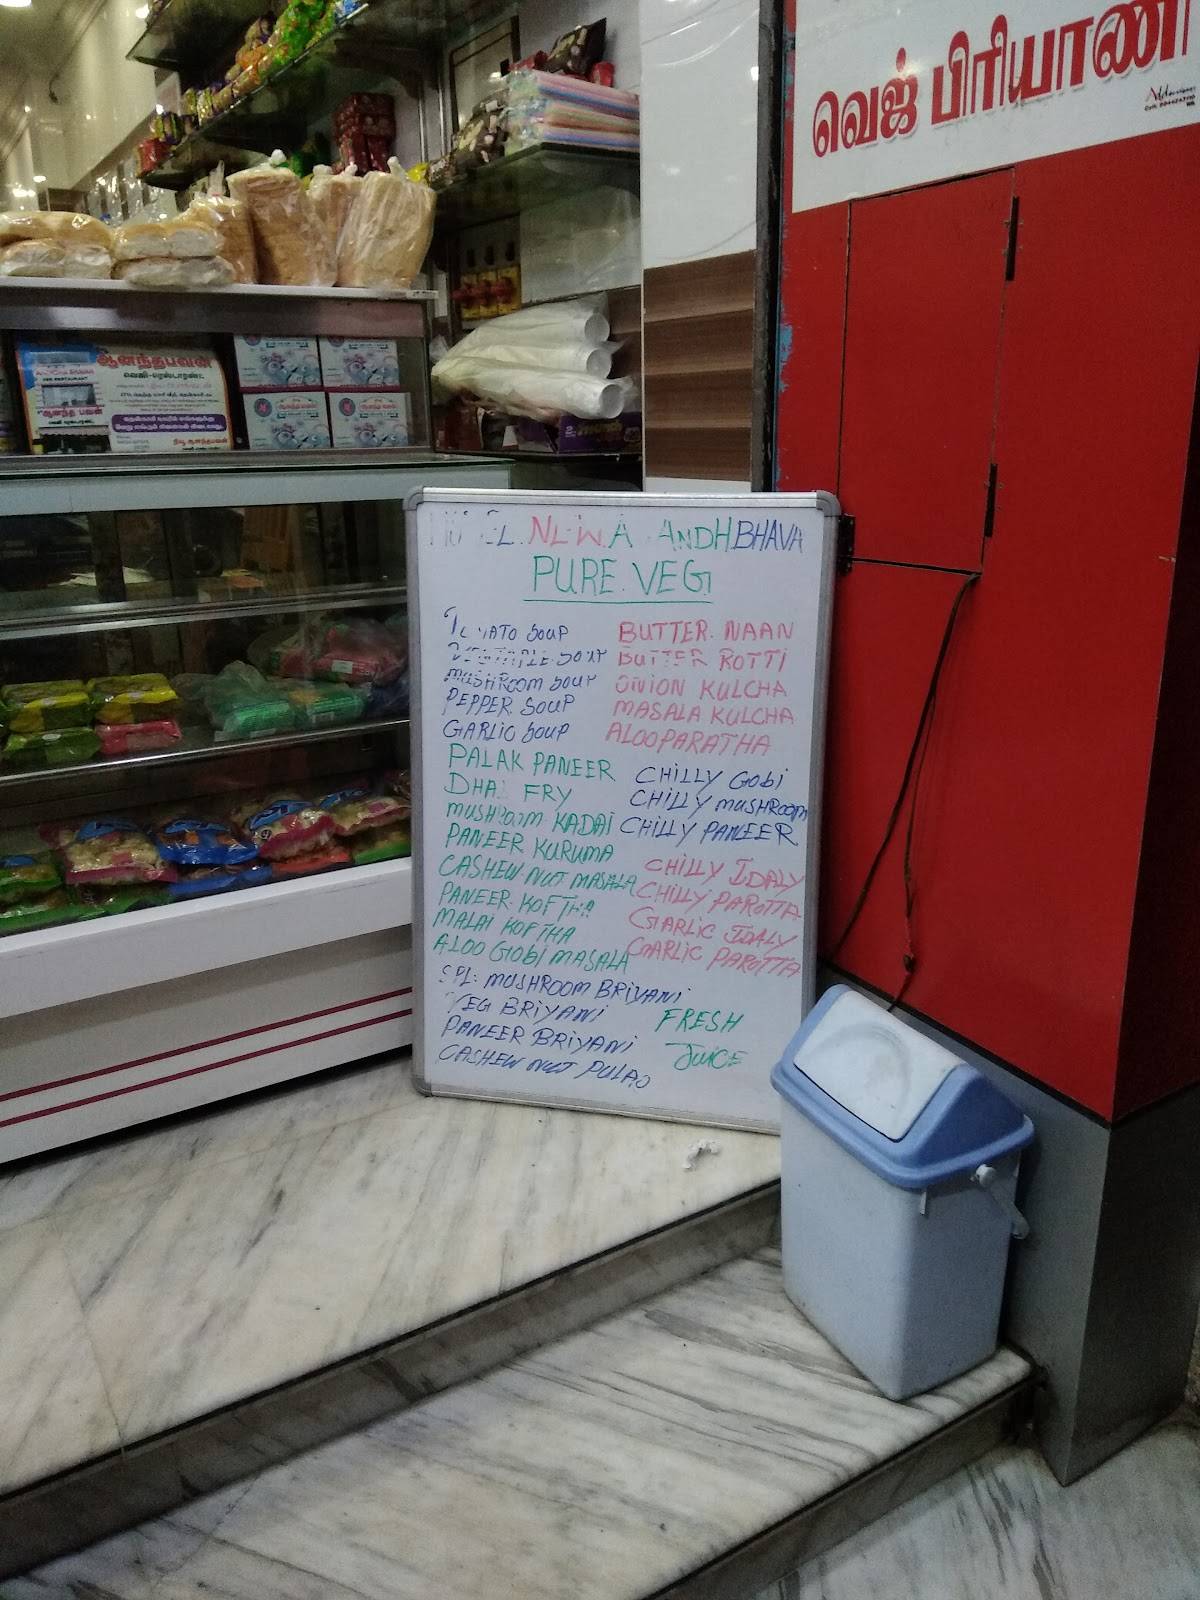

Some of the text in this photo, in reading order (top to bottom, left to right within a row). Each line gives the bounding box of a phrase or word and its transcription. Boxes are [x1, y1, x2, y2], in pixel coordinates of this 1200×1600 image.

[533, 555, 712, 596] PURE VEG
[526, 623, 569, 642] SOUP
[724, 619, 794, 642] NAAN
[441, 687, 575, 717] PEPPER SOUP
[699, 679, 787, 701] KULCHA
[613, 699, 795, 726] MASALA KULCHA
[521, 721, 570, 743] SOUP
[449, 743, 616, 781] PALAK PANEER
[523, 784, 573, 811] FRY
[445, 822, 614, 865] PANEER KURUMA
[700, 821, 799, 846] PANEER
[439, 854, 525, 881] CASHEW
[524, 867, 569, 887] NUT
[438, 881, 513, 910] PANEER
[432, 907, 495, 932] MALAI
[433, 932, 485, 957] ALOO
[551, 948, 630, 974] MASALA
[484, 972, 591, 996] MUSHROOM
[440, 1014, 525, 1045] PANEER
[655, 1008, 744, 1032] FRESH
[438, 1043, 525, 1070] CASHEW
